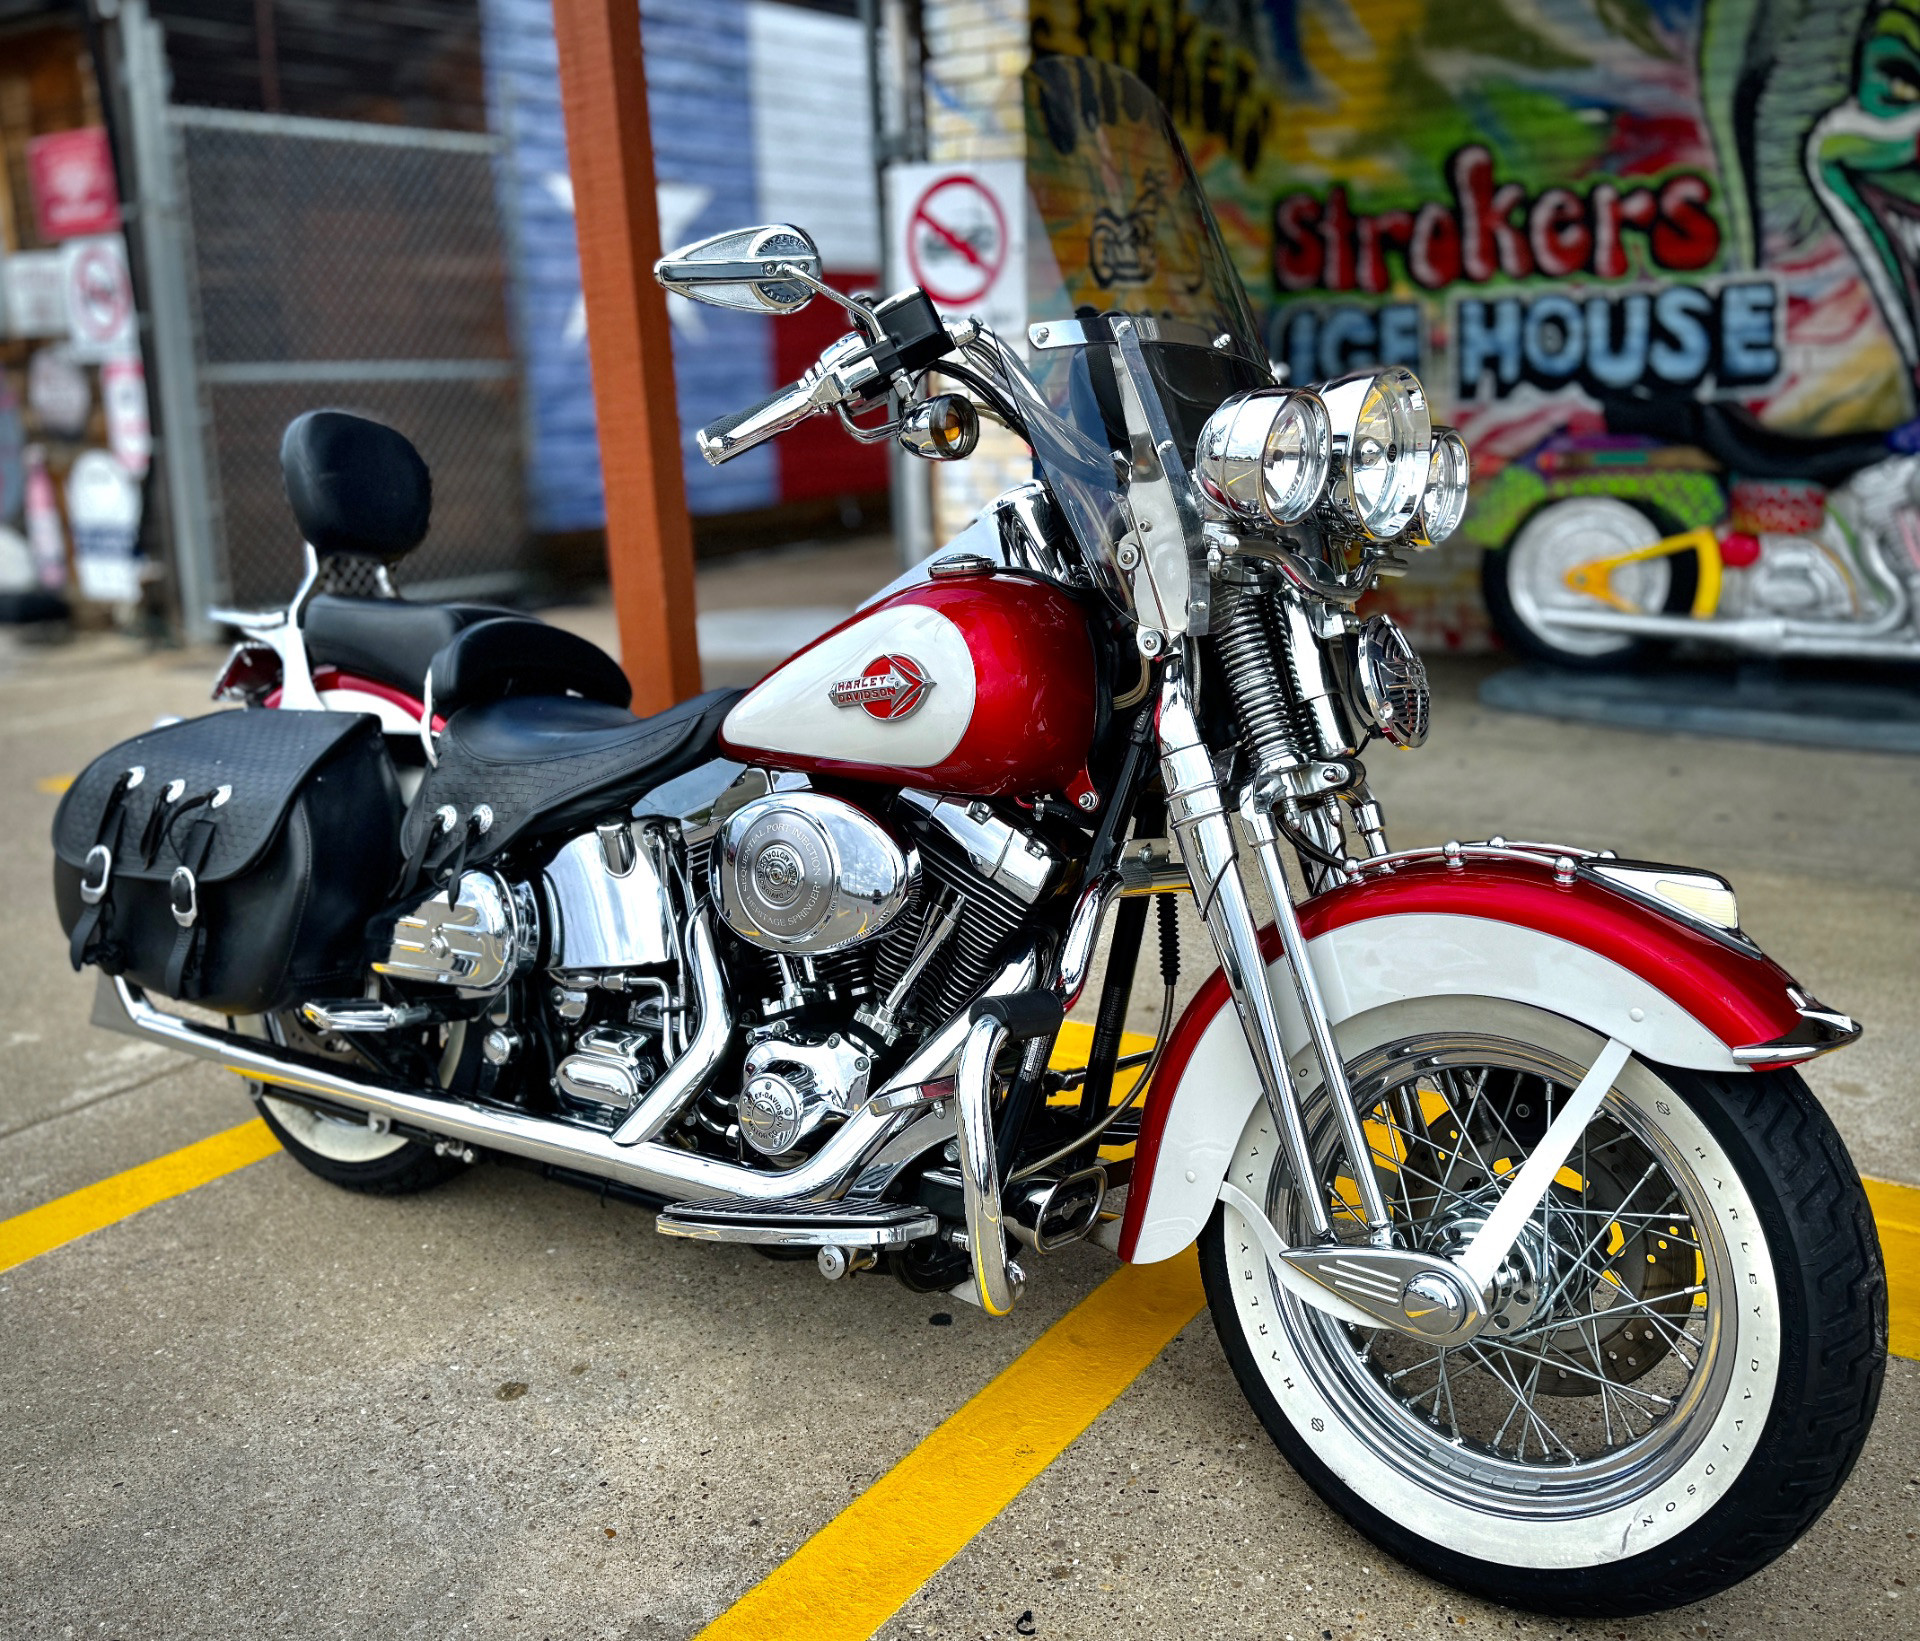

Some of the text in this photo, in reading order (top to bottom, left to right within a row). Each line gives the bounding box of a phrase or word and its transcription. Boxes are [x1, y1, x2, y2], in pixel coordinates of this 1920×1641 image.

[1457, 281, 1780, 392] HOUSE
[837, 687, 897, 703] DAVIDSON
[741, 822, 822, 893] SEQUENTIAL PORT INJECTION
[746, 1091, 784, 1129] HALEY-DAVIDSON
